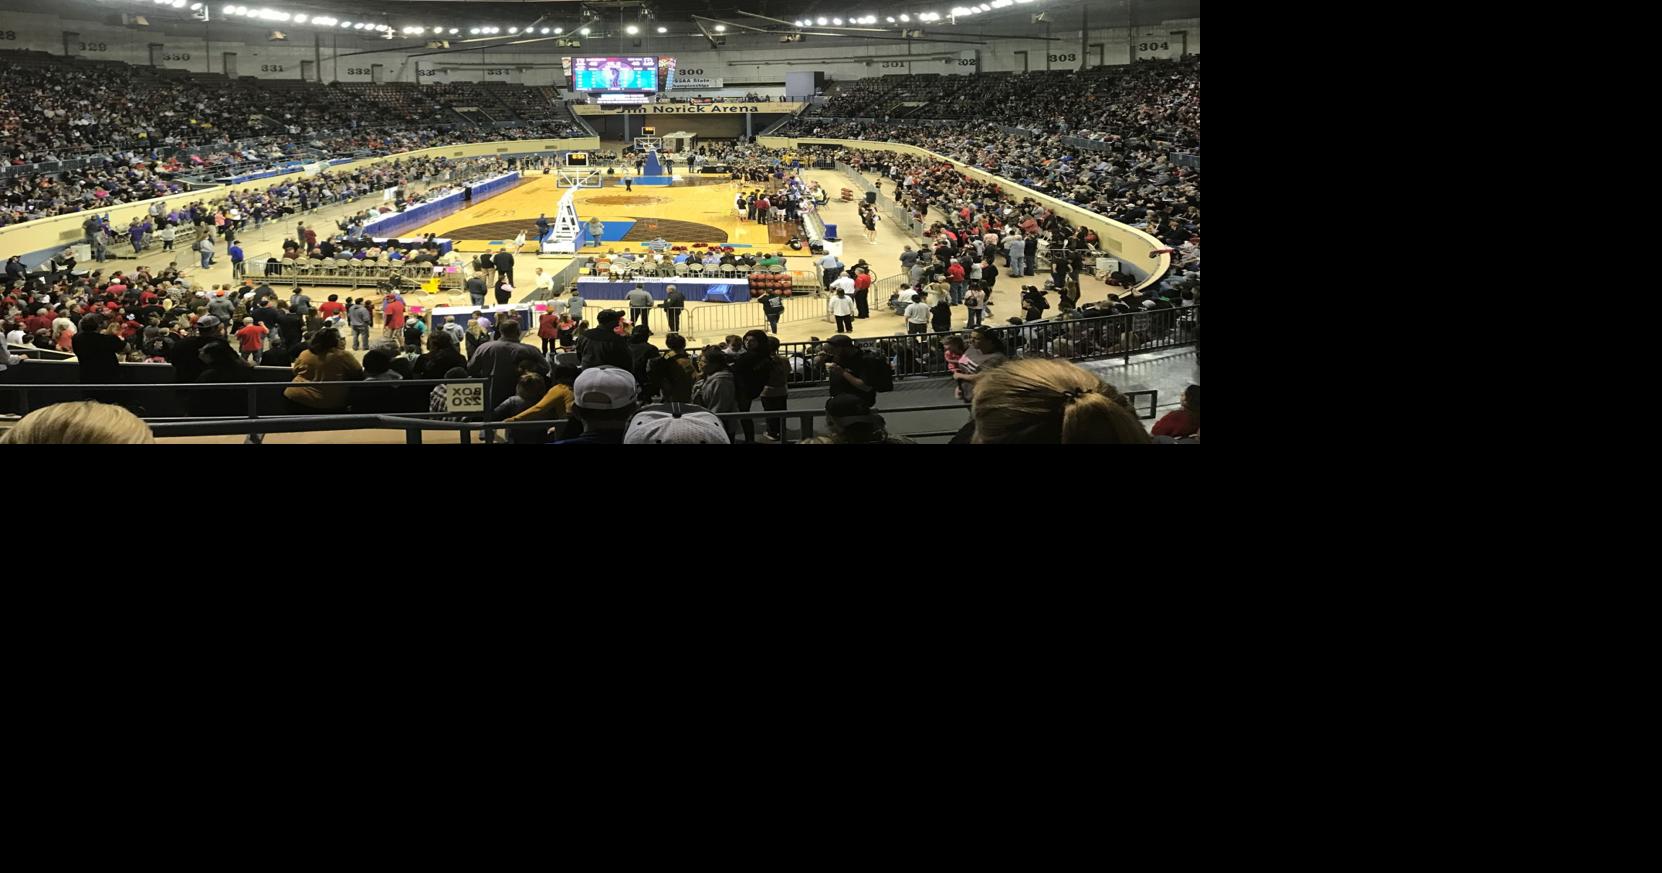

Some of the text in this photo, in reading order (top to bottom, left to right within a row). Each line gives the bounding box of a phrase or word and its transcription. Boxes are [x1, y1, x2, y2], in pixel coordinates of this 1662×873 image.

[1139, 42, 1169, 51] 304
[1048, 53, 1077, 62] 303
[261, 64, 284, 72] 331
[653, 104, 705, 114] Norick
[711, 105, 759, 113] Arena
